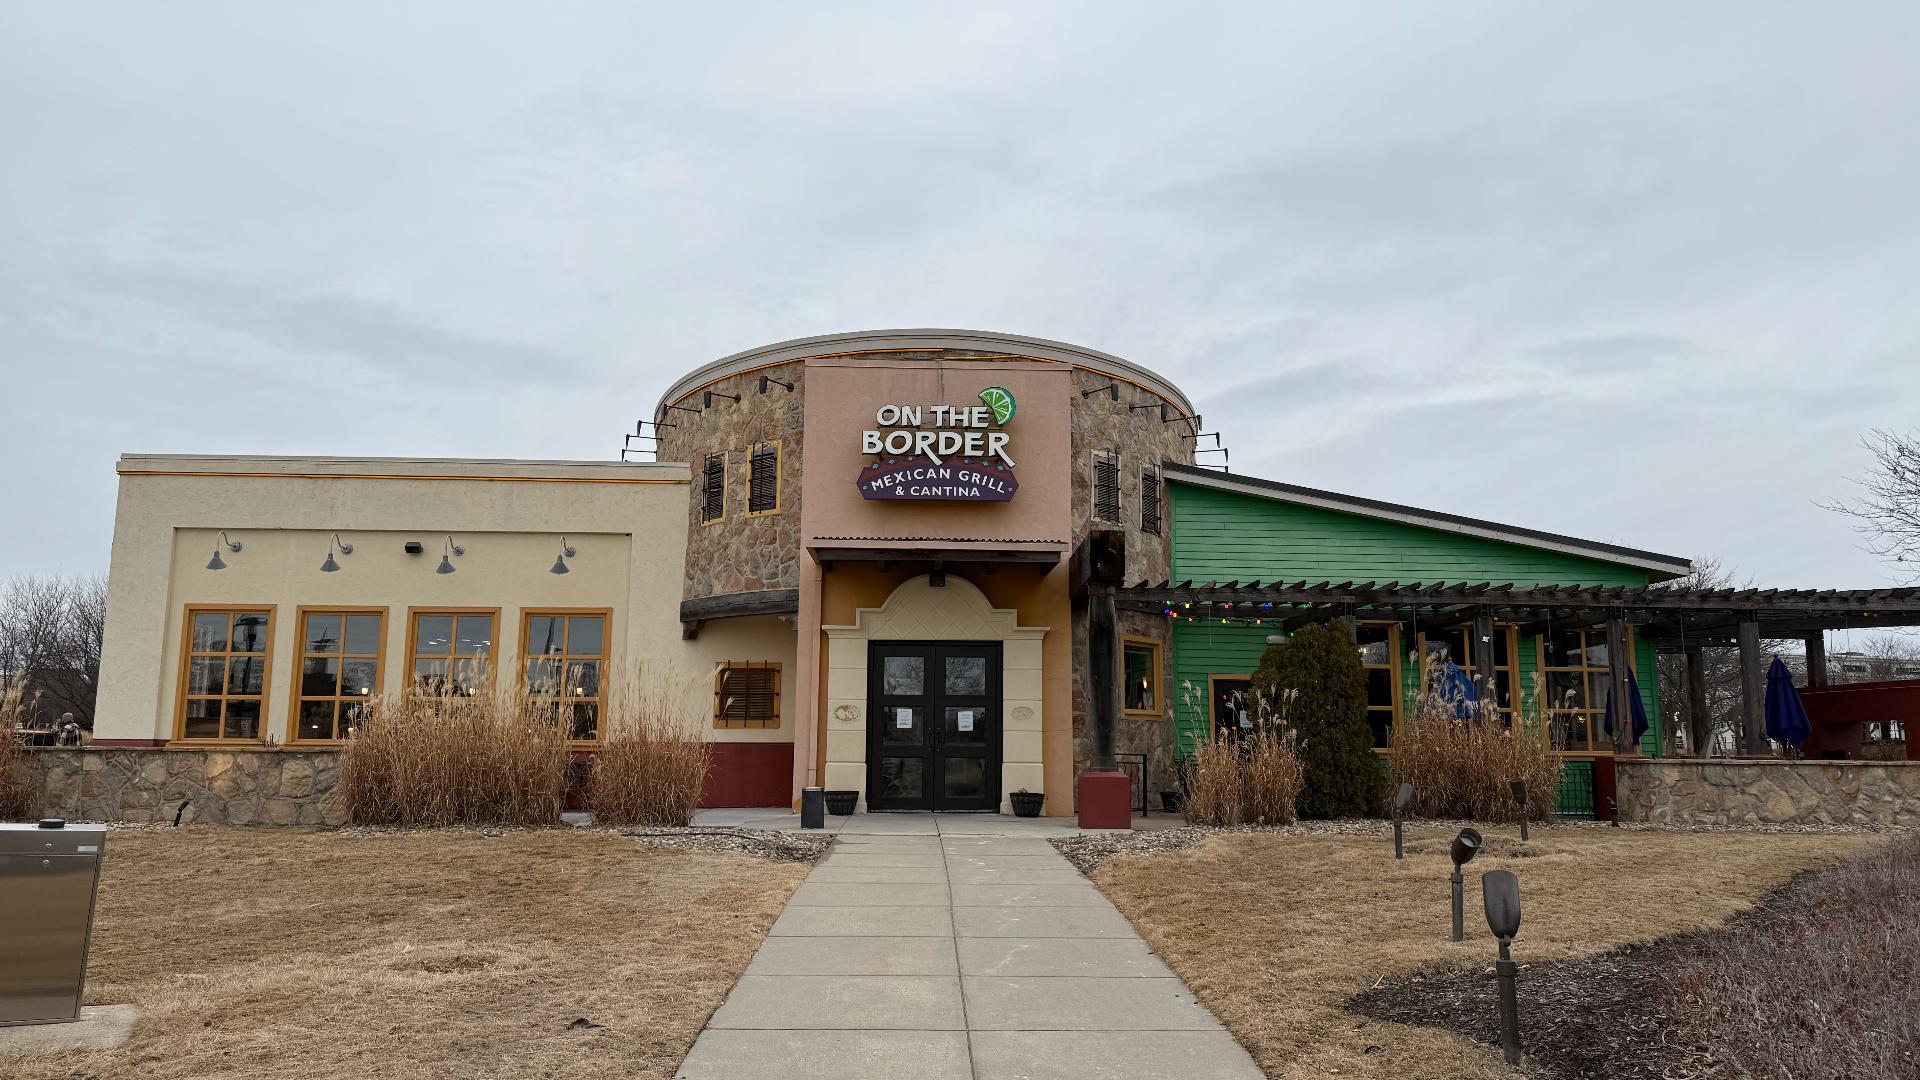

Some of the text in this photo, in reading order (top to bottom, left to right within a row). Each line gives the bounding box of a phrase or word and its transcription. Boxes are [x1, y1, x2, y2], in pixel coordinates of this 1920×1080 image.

[876, 404, 989, 428] ON THE
[862, 430, 1016, 467] BORDER
[870, 468, 1005, 494] MEXICAN GRILL
[895, 486, 980, 497] & CANTINA
